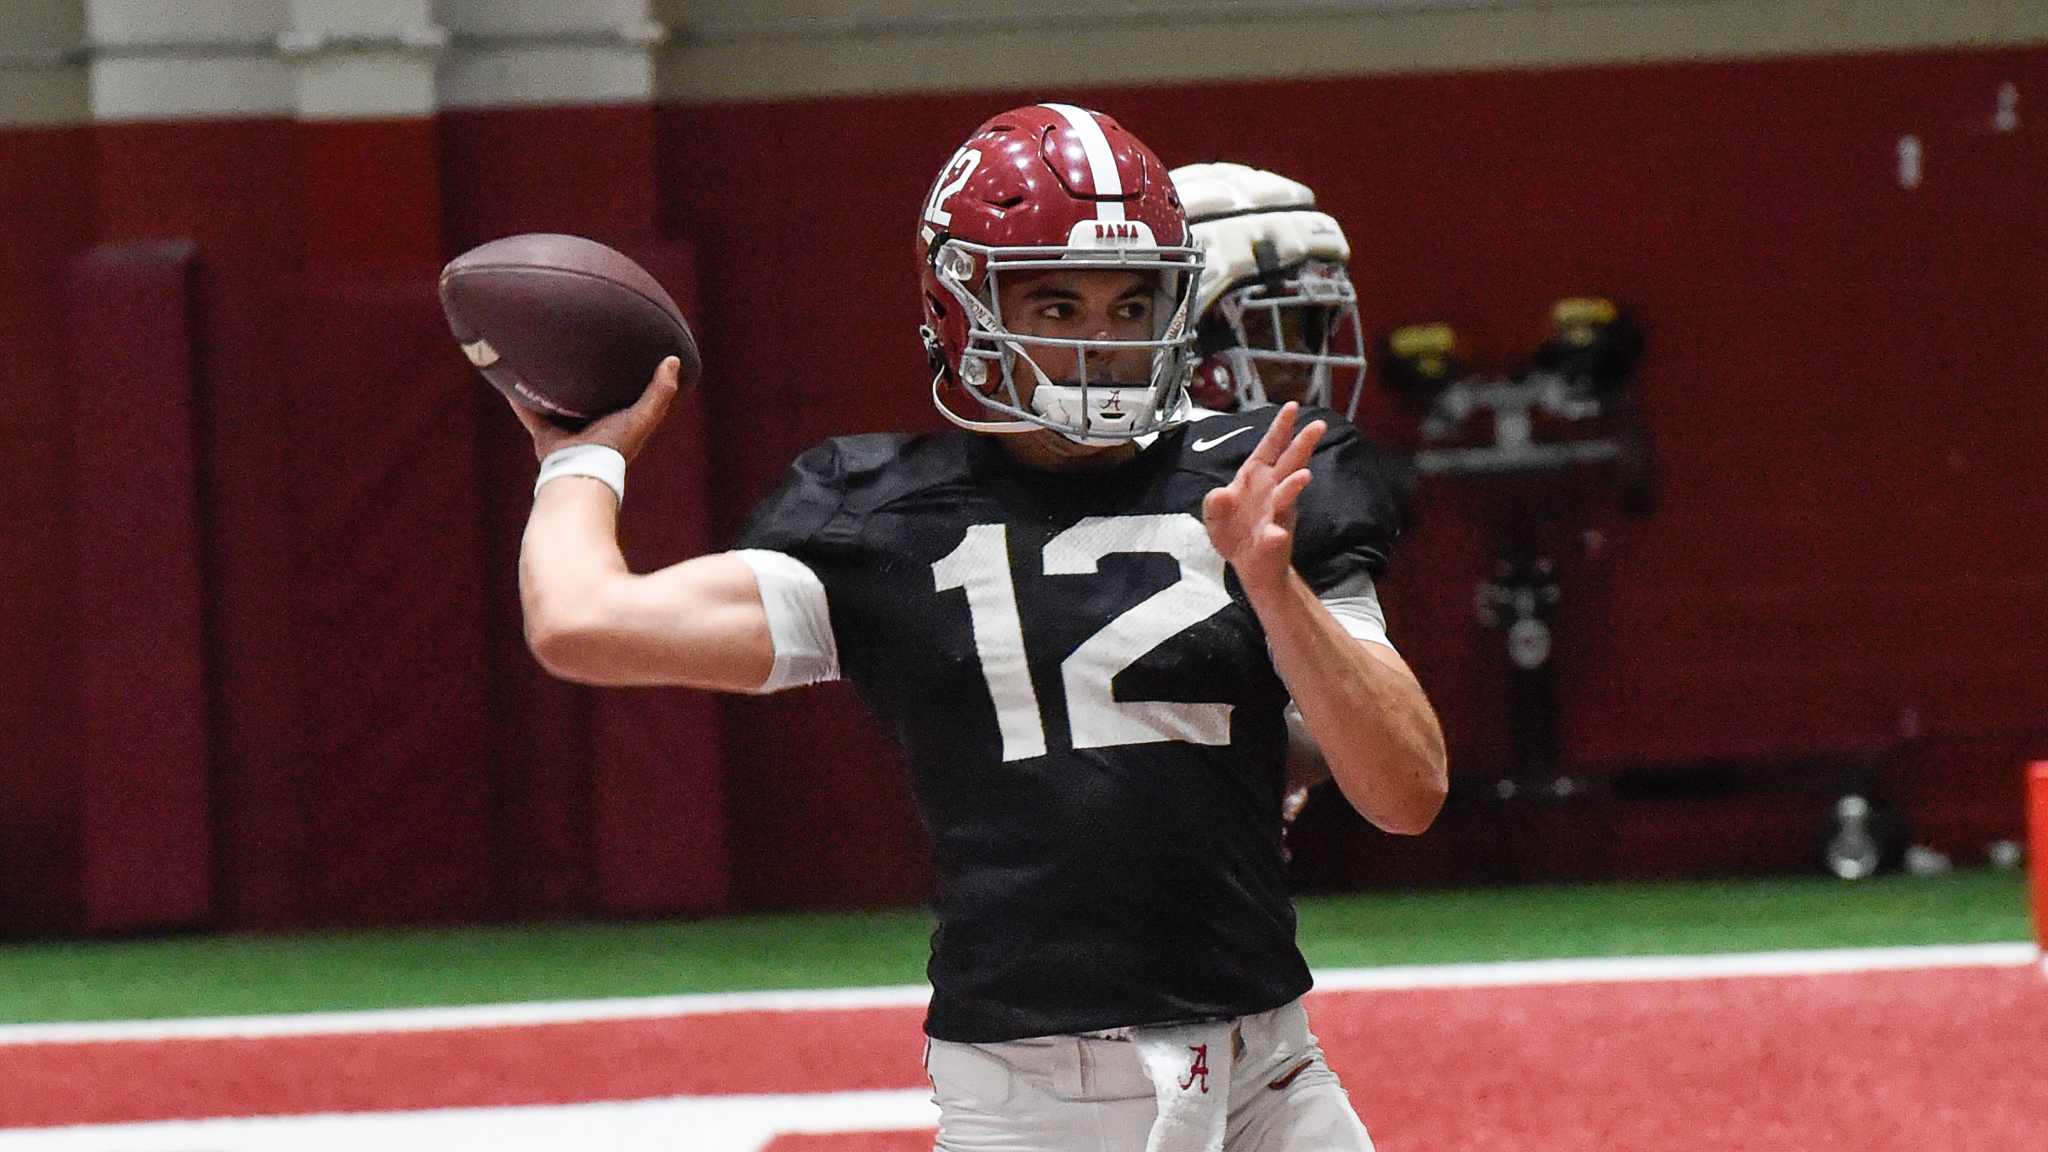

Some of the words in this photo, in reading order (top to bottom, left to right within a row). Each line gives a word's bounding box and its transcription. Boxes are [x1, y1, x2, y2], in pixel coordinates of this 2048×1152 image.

[924, 146, 982, 227] 12
[1095, 223, 1139, 238] BAMA
[1100, 390, 1121, 411] A
[931, 512, 1236, 762] 12
[1177, 1043, 1209, 1094] A
